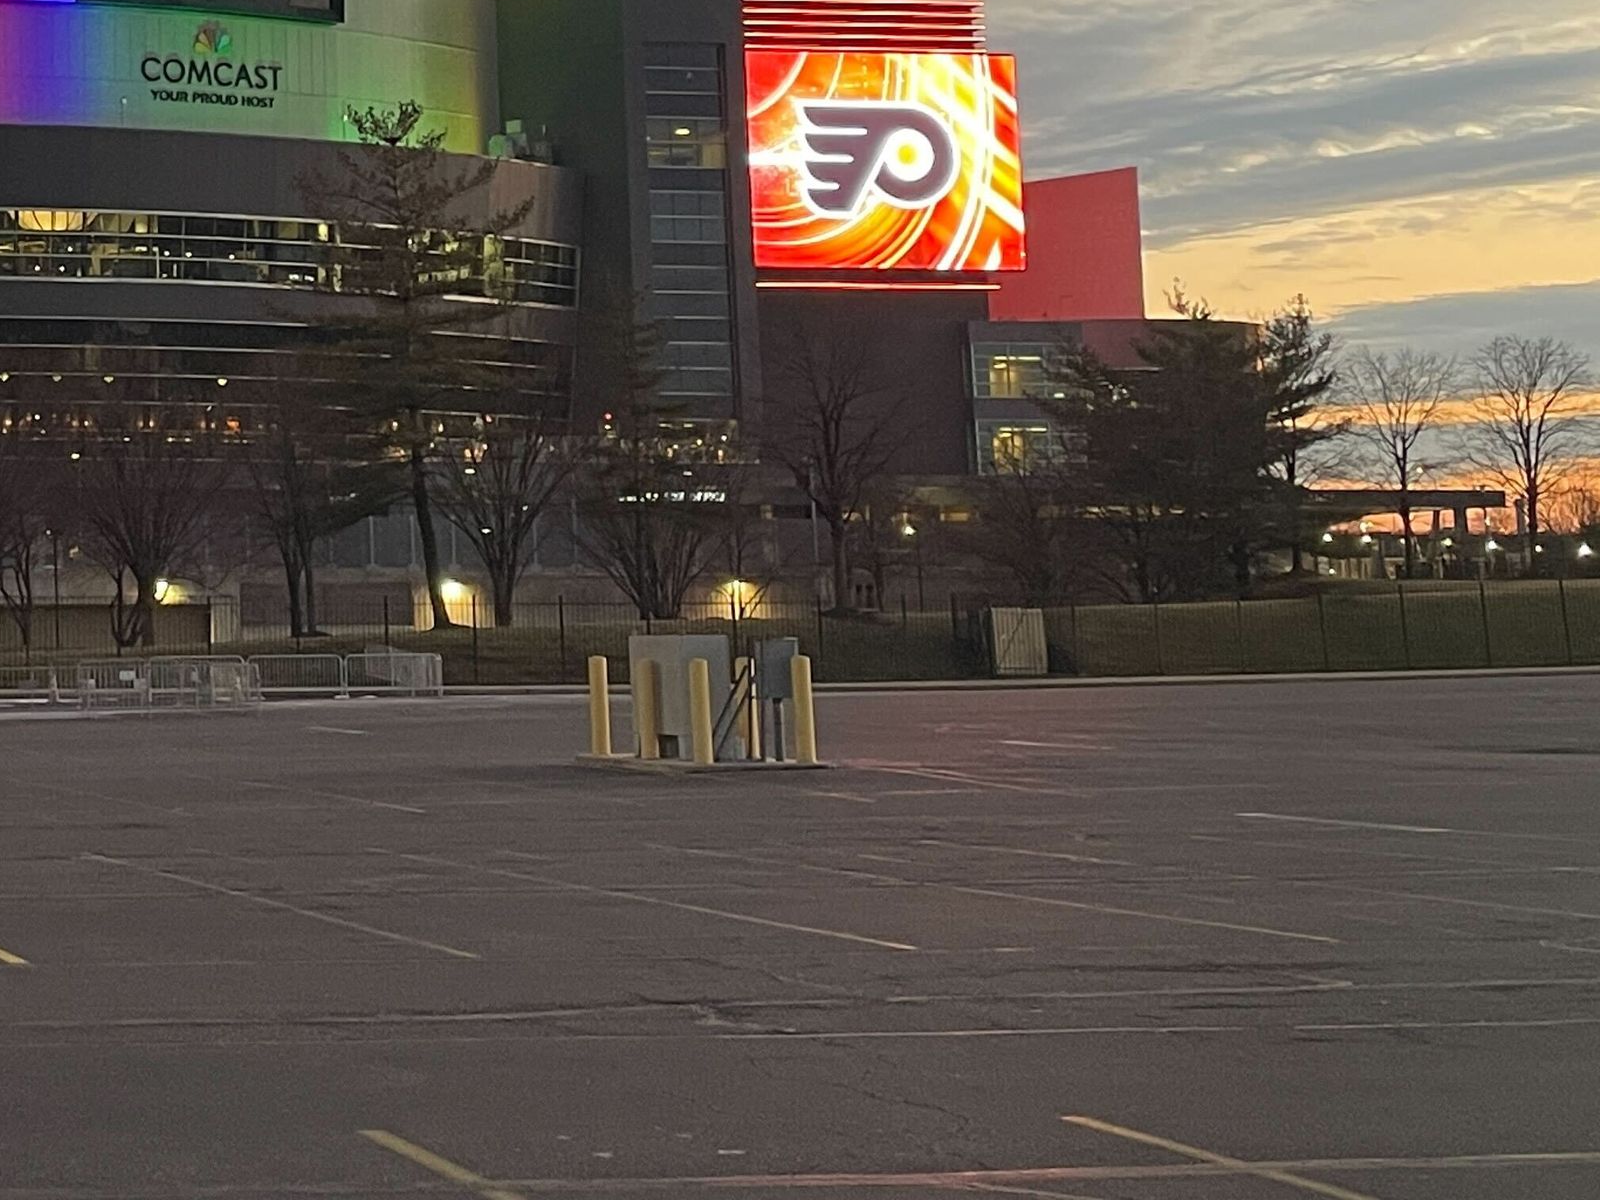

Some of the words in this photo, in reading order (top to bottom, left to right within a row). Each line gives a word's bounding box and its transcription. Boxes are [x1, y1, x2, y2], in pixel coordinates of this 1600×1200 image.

[141, 57, 282, 91] COMCAST
[151, 89, 189, 103] YOUR
[192, 93, 239, 106] PROUD
[241, 96, 275, 109] HOST
